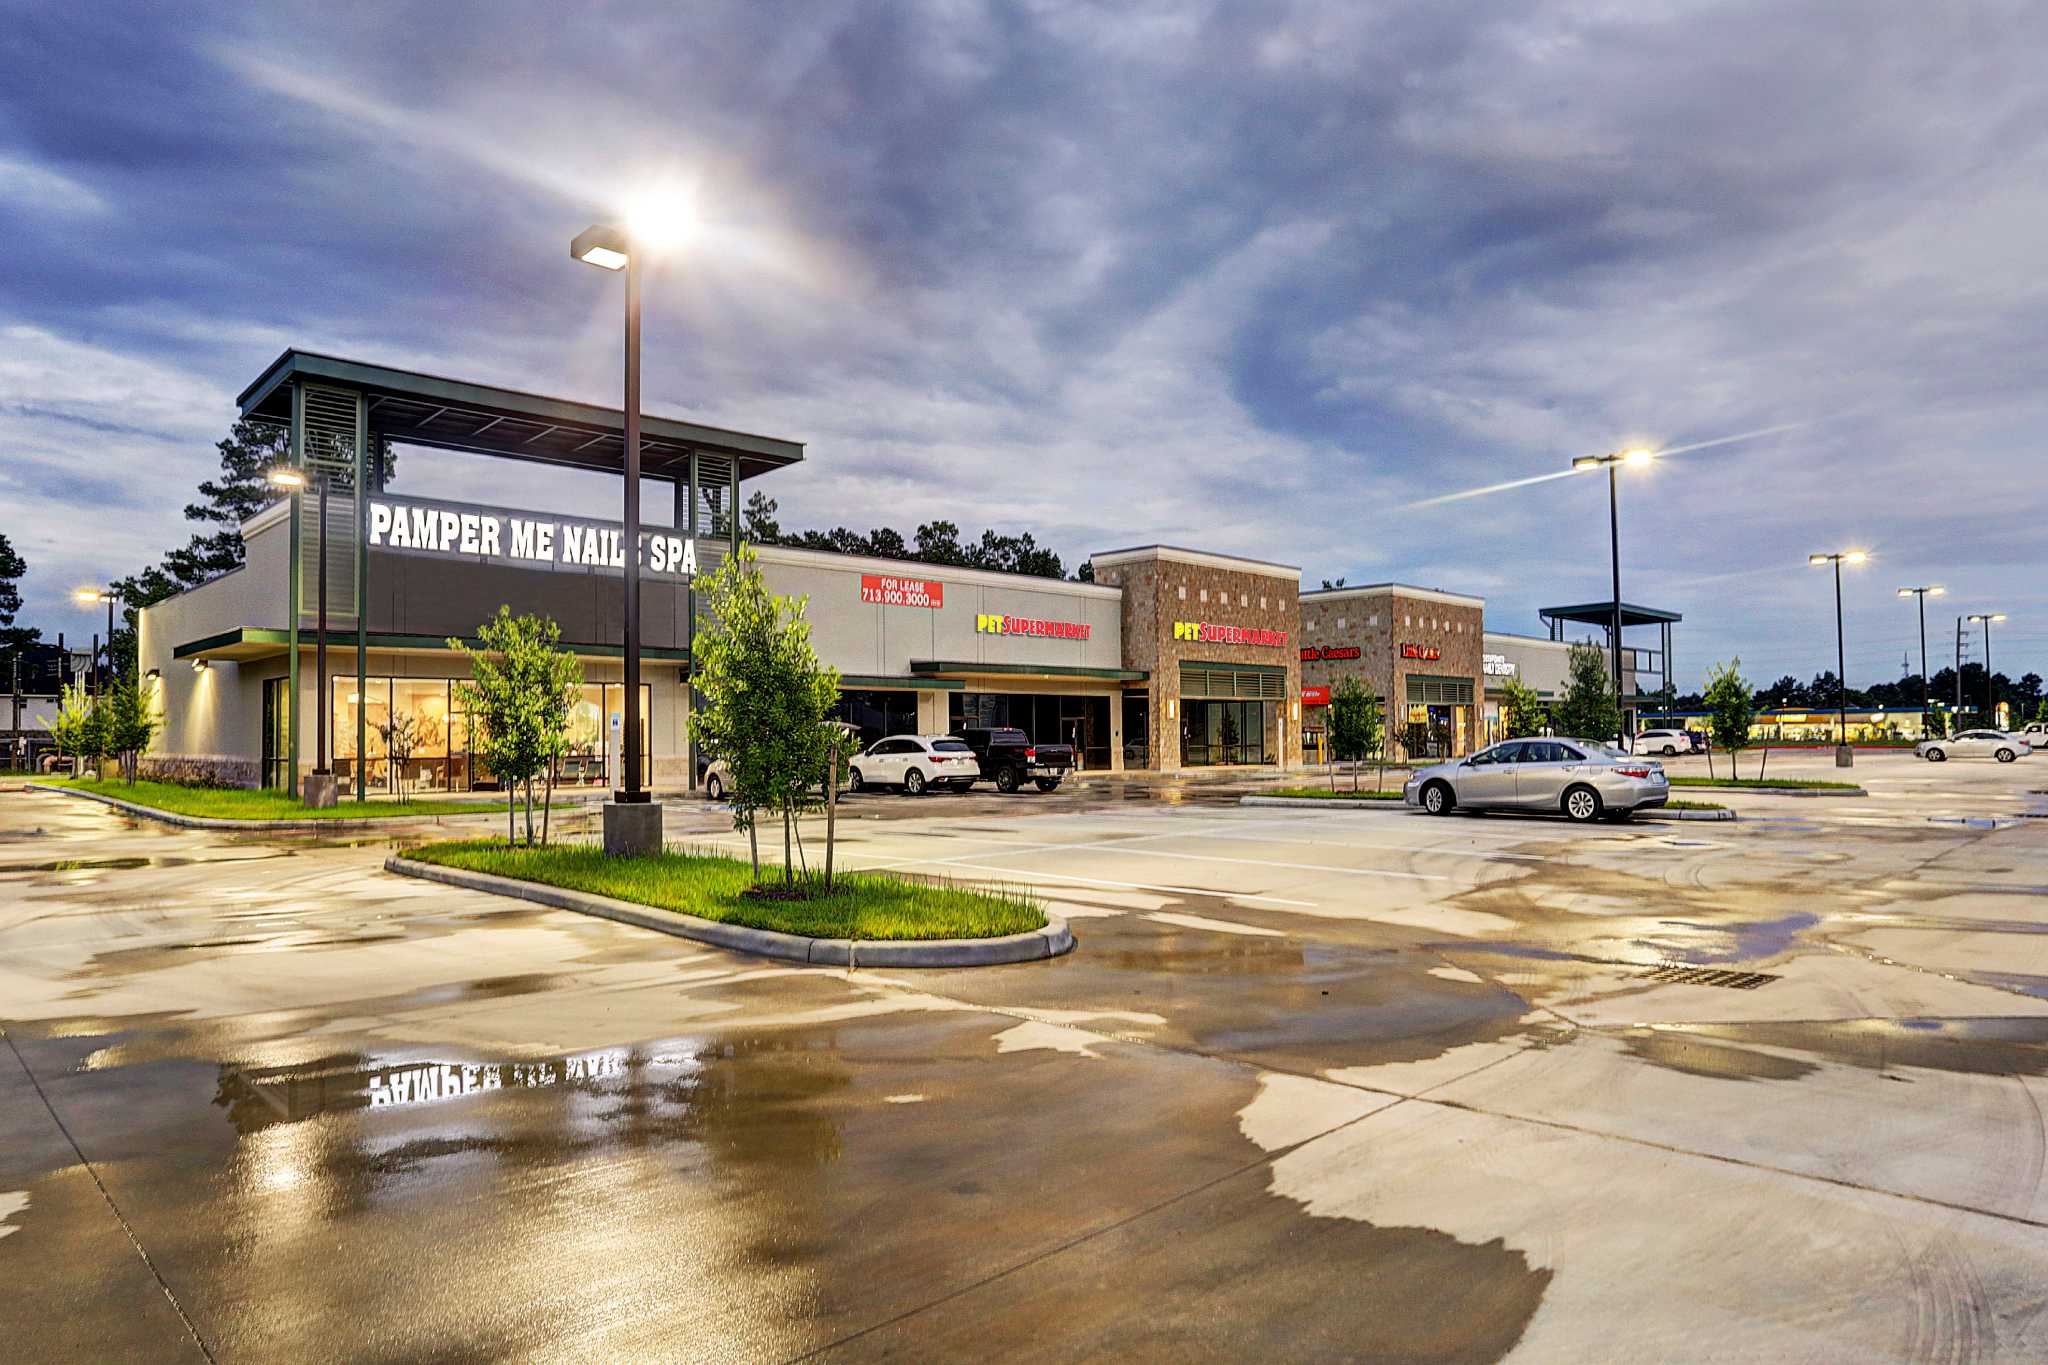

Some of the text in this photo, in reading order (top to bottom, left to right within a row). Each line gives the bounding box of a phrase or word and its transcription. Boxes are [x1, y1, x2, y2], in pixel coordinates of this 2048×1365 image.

[369, 502, 698, 576] PAMPER ME NAIL SPA
[881, 578, 925, 594] FOR LEASE
[862, 588, 930, 607] 713.900.3000
[1321, 645, 1361, 660] Caesars
